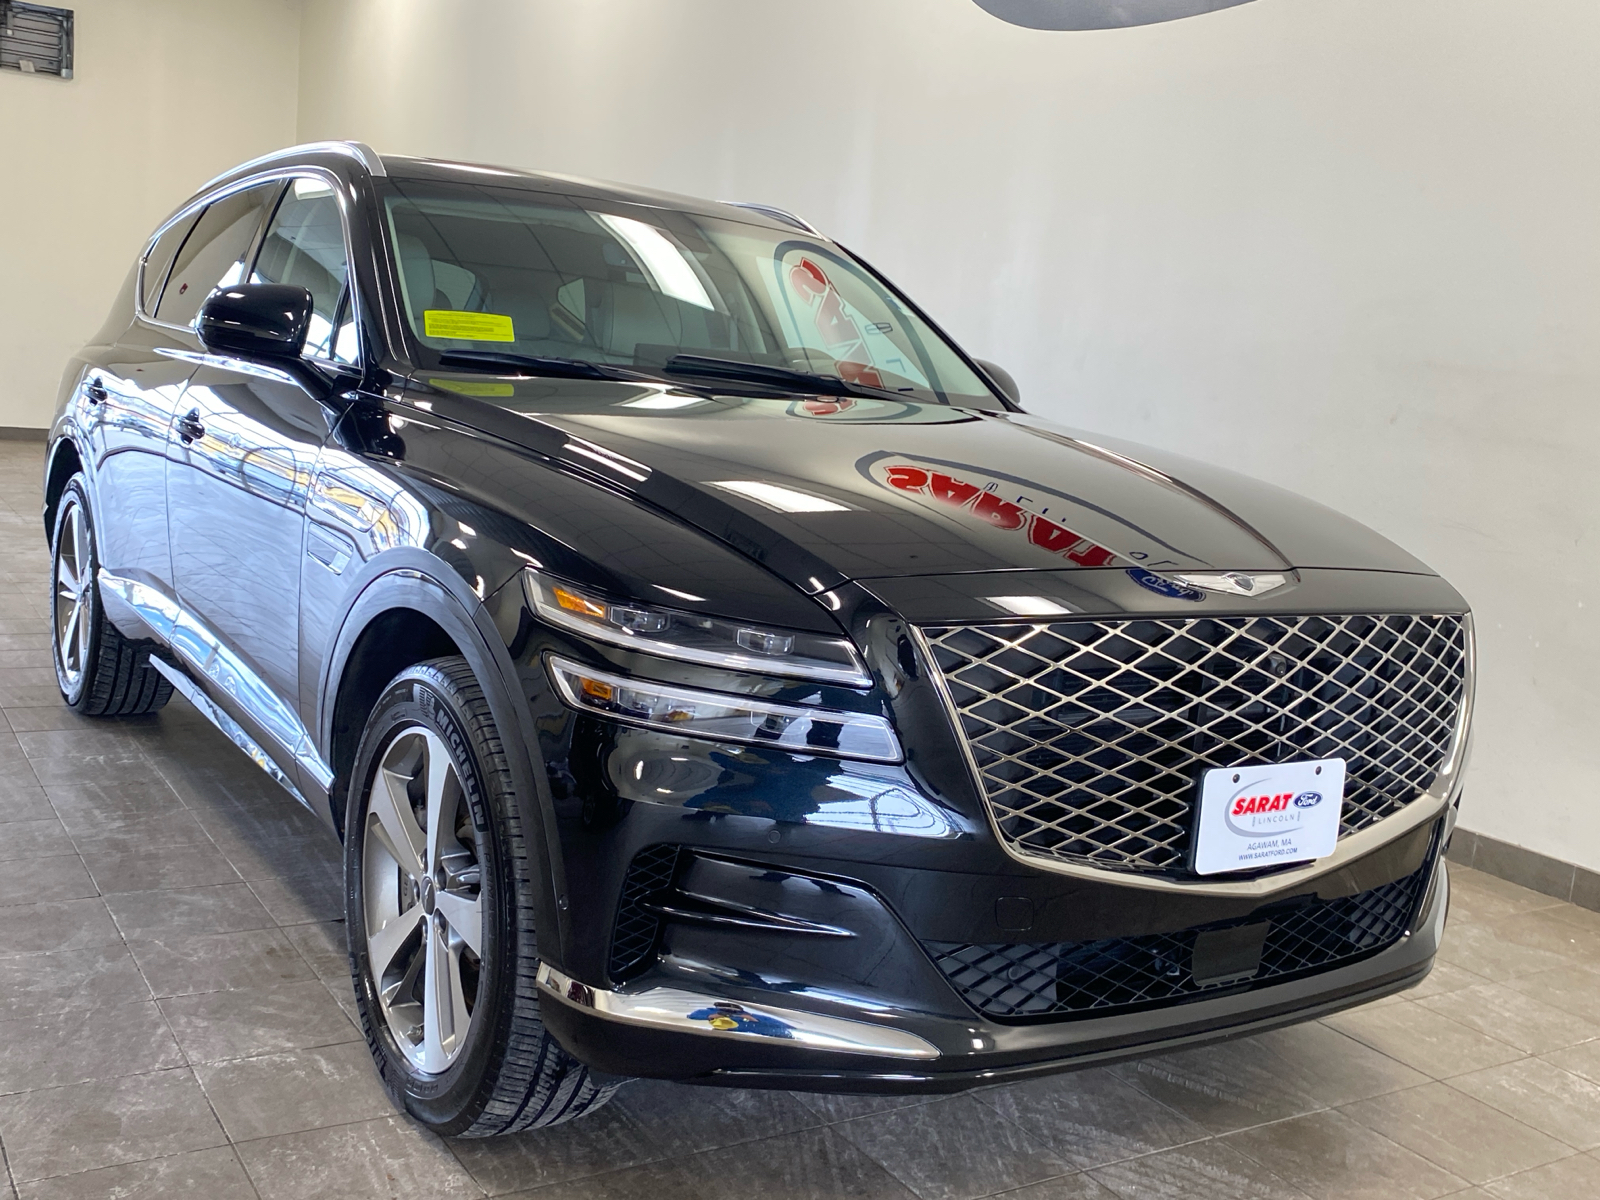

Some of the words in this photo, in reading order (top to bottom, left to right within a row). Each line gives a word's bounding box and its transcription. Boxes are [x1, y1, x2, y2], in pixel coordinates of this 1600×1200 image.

[435, 709, 485, 825] MICHELIN
[1231, 792, 1294, 816] SARAT
[1296, 793, 1319, 807] Ford
[1258, 815, 1295, 825] LINCOLN
[1247, 840, 1280, 850] AGAWAM,
[1281, 838, 1292, 846] MA
[1239, 848, 1297, 860] WWW.SARATFORD.COM
